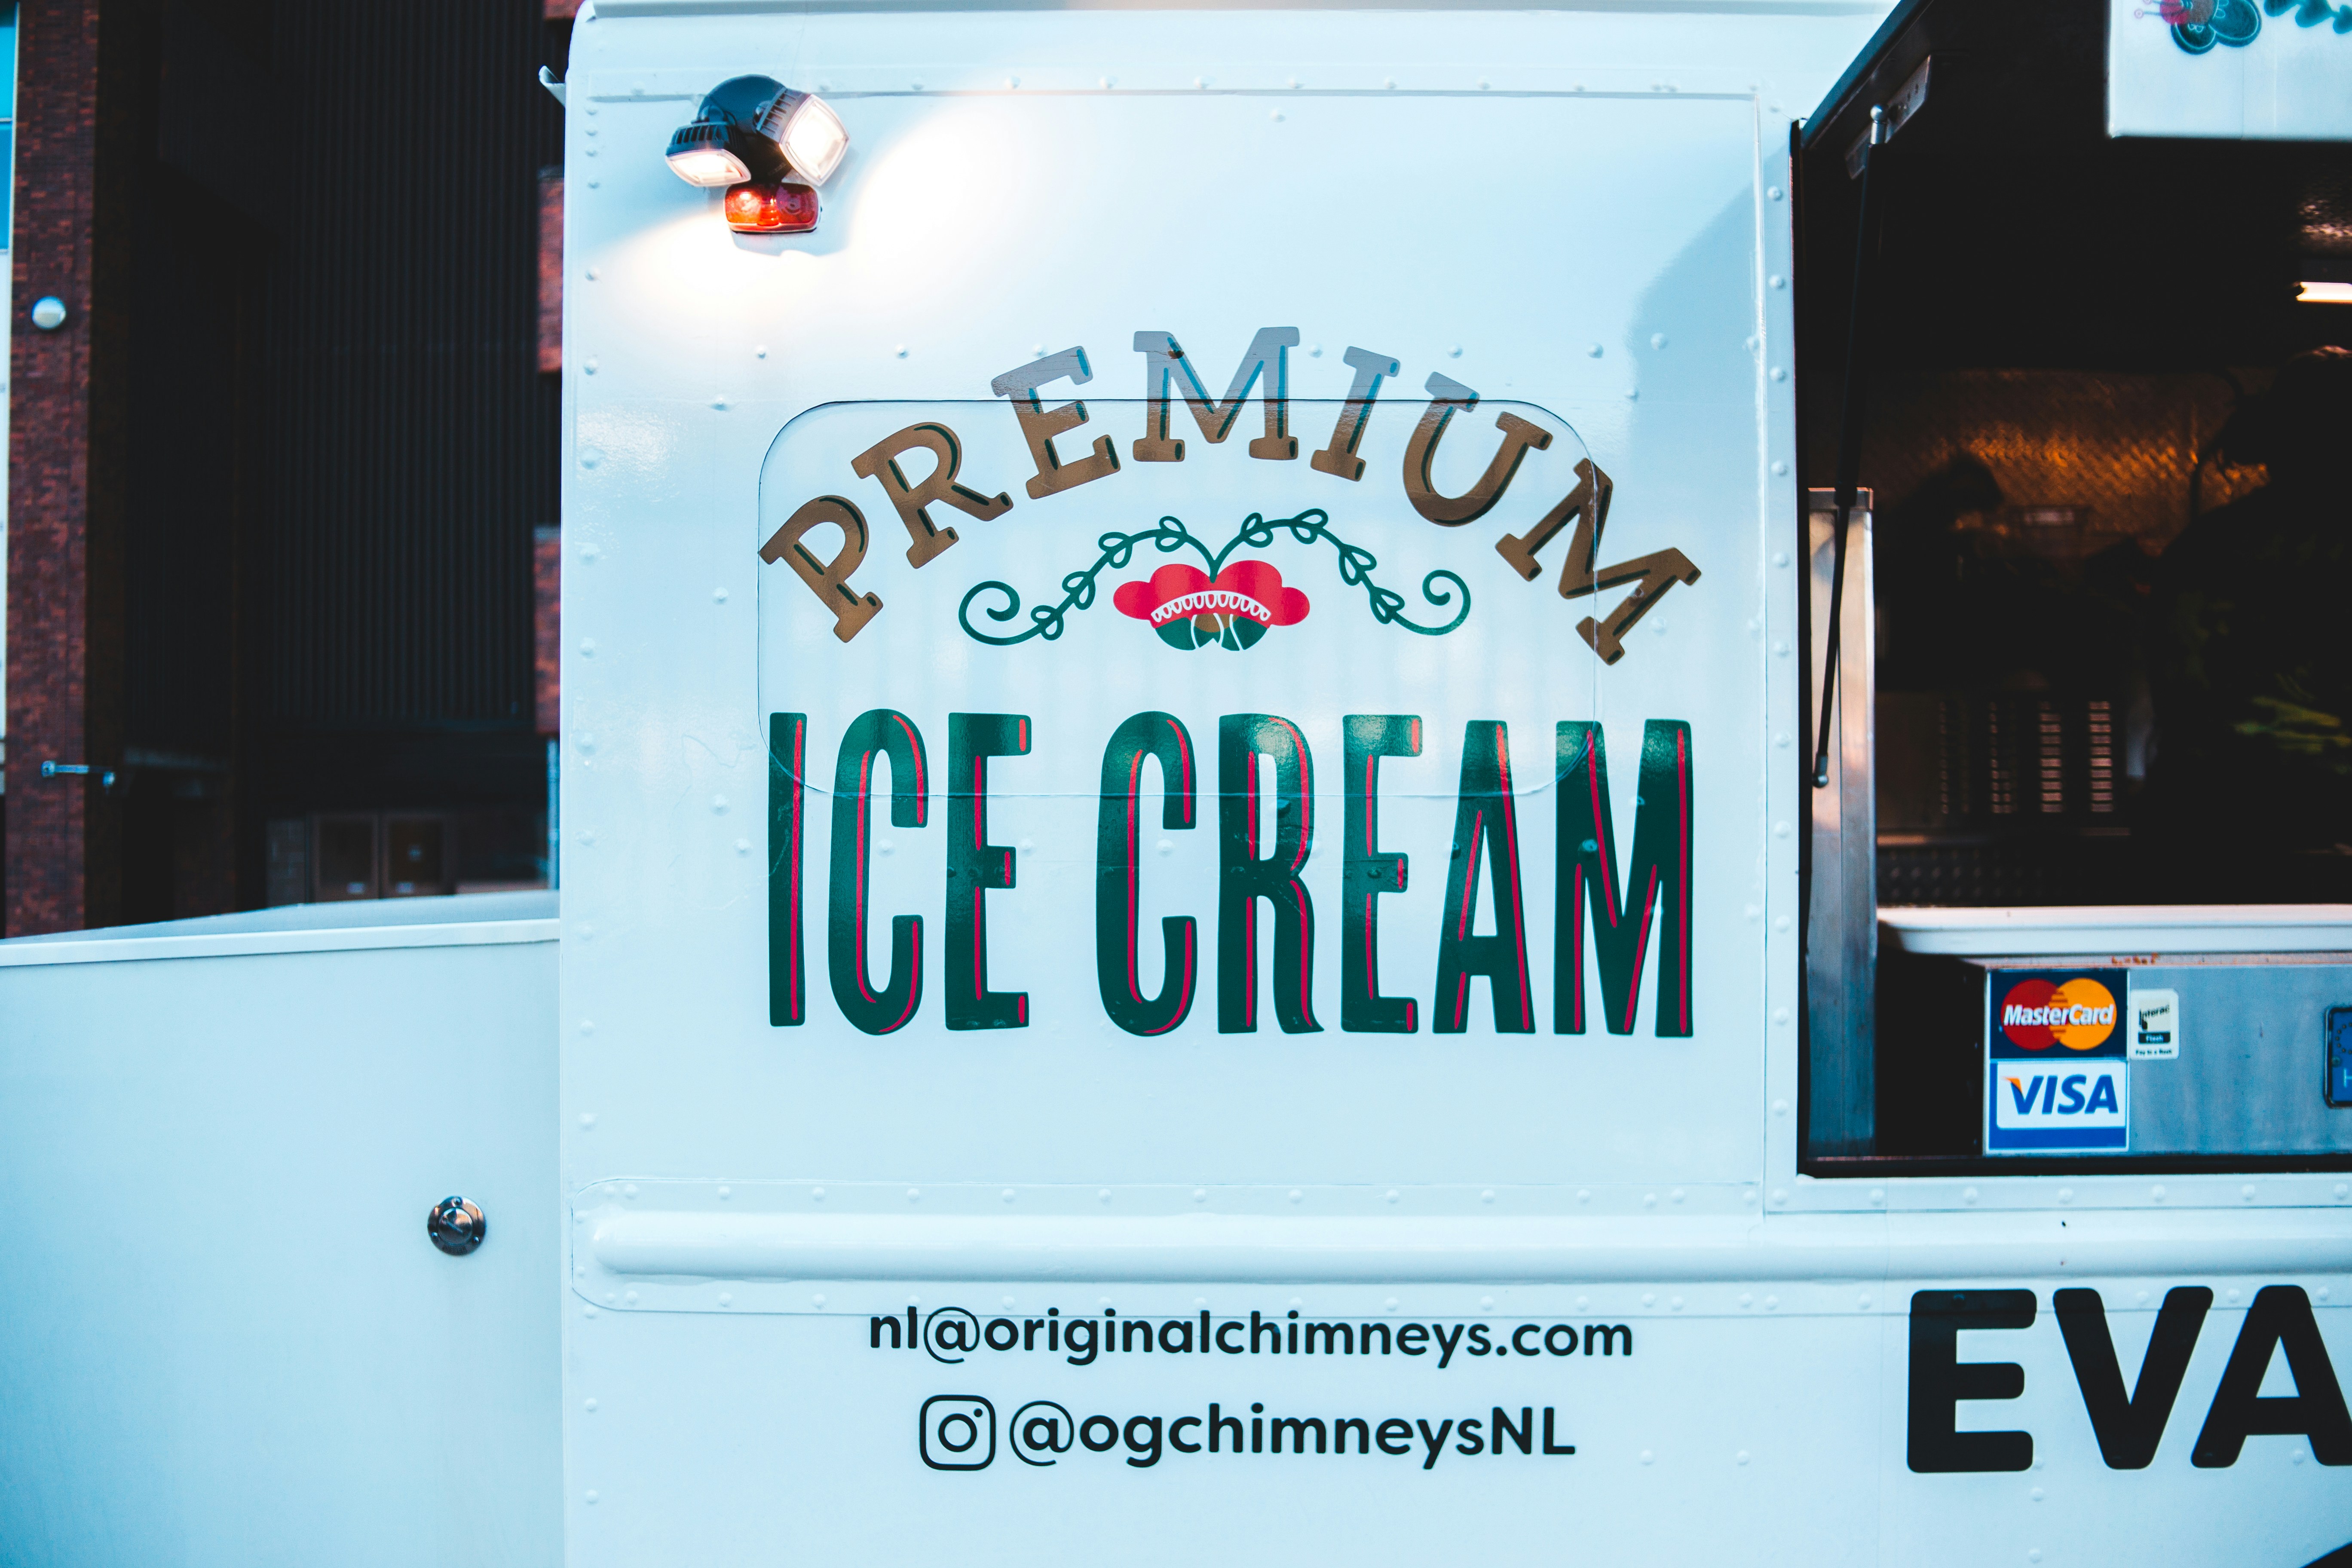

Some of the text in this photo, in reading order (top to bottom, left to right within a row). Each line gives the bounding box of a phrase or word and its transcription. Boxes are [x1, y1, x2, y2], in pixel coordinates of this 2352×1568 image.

[760, 326, 1702, 665] PREMIUM
[767, 708, 1694, 1039] ICE CREAM
[2003, 1004, 2114, 1026] MasterCard
[2002, 1074, 2119, 1115] VISA
[870, 1306, 1632, 1369] nl@originalchimneys.com
[1907, 1285, 2352, 1473] EVA
[1009, 1400, 1576, 1470] @ogchimneysNL
